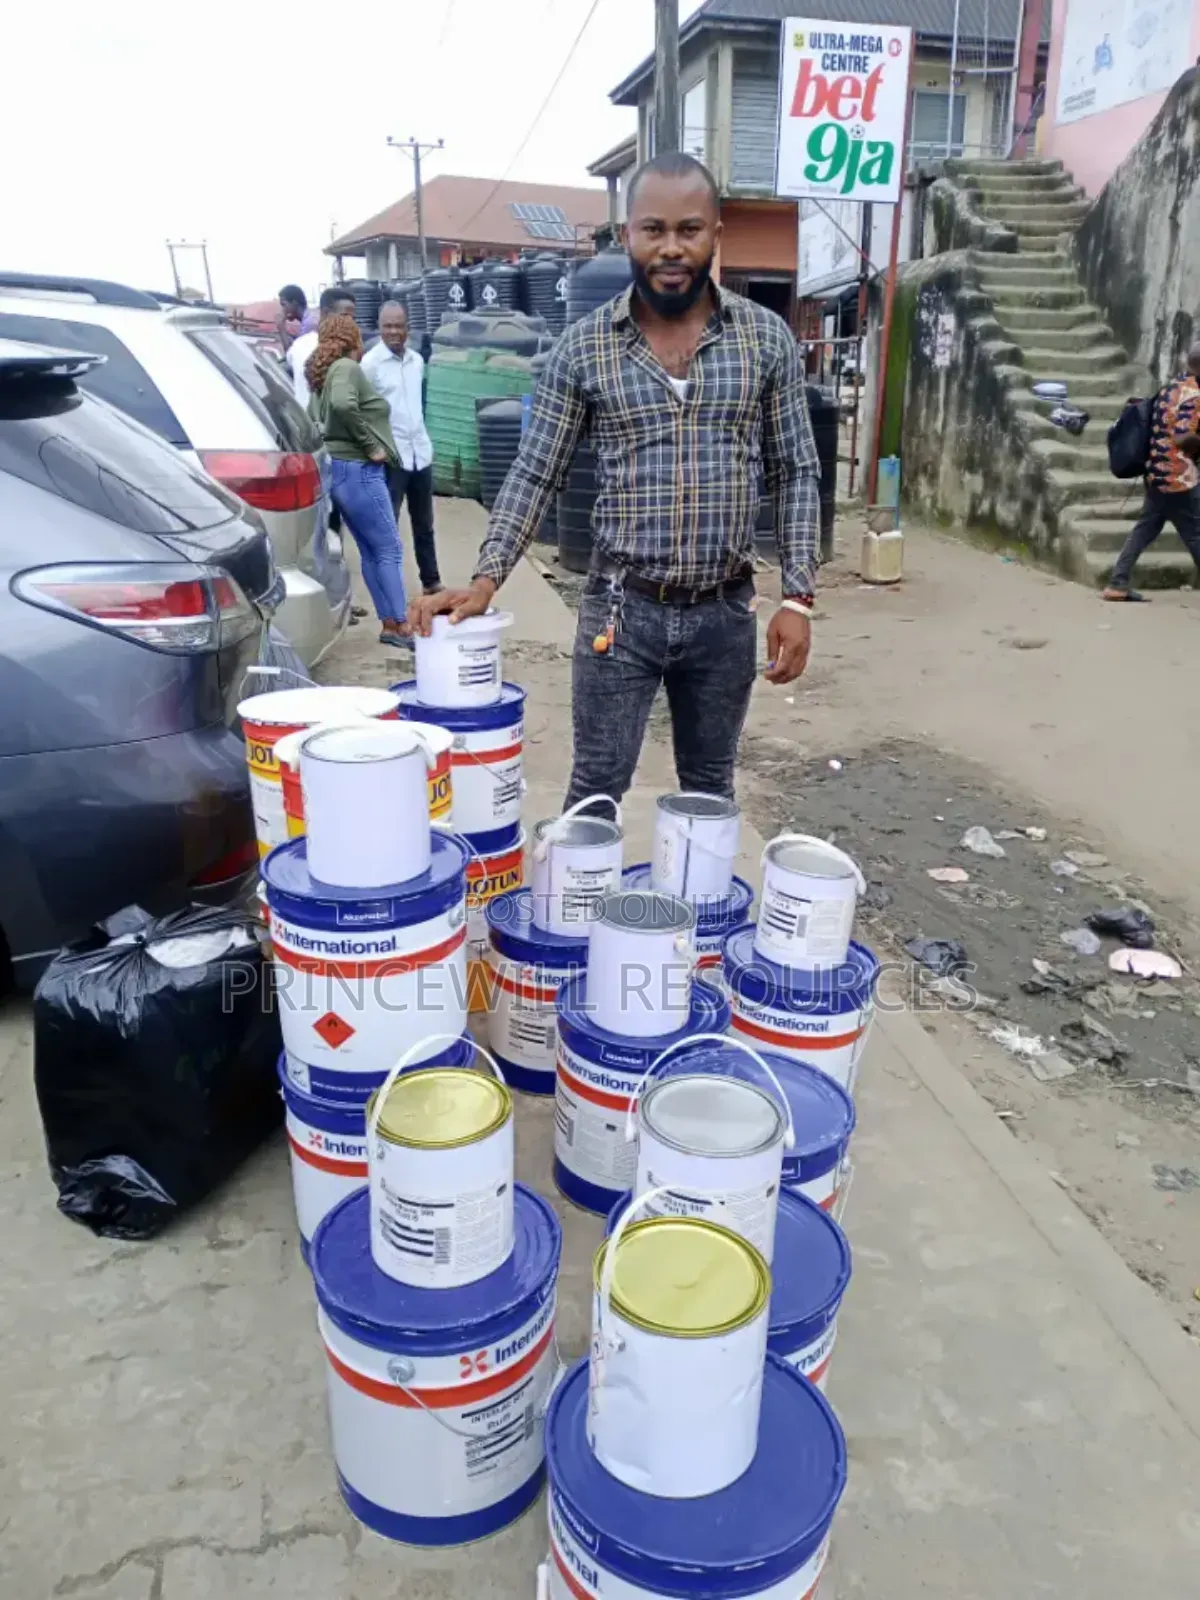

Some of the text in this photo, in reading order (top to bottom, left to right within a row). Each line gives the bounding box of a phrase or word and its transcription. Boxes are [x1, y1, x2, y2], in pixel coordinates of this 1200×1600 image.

[809, 31, 884, 53] ULTRA-MEGA
[821, 53, 870, 74] CENTRE
[790, 58, 886, 122] bet
[803, 122, 894, 195] 9ja
[250, 743, 274, 765] JOT
[284, 928, 397, 955] International
[324, 1137, 368, 1157] Inter
